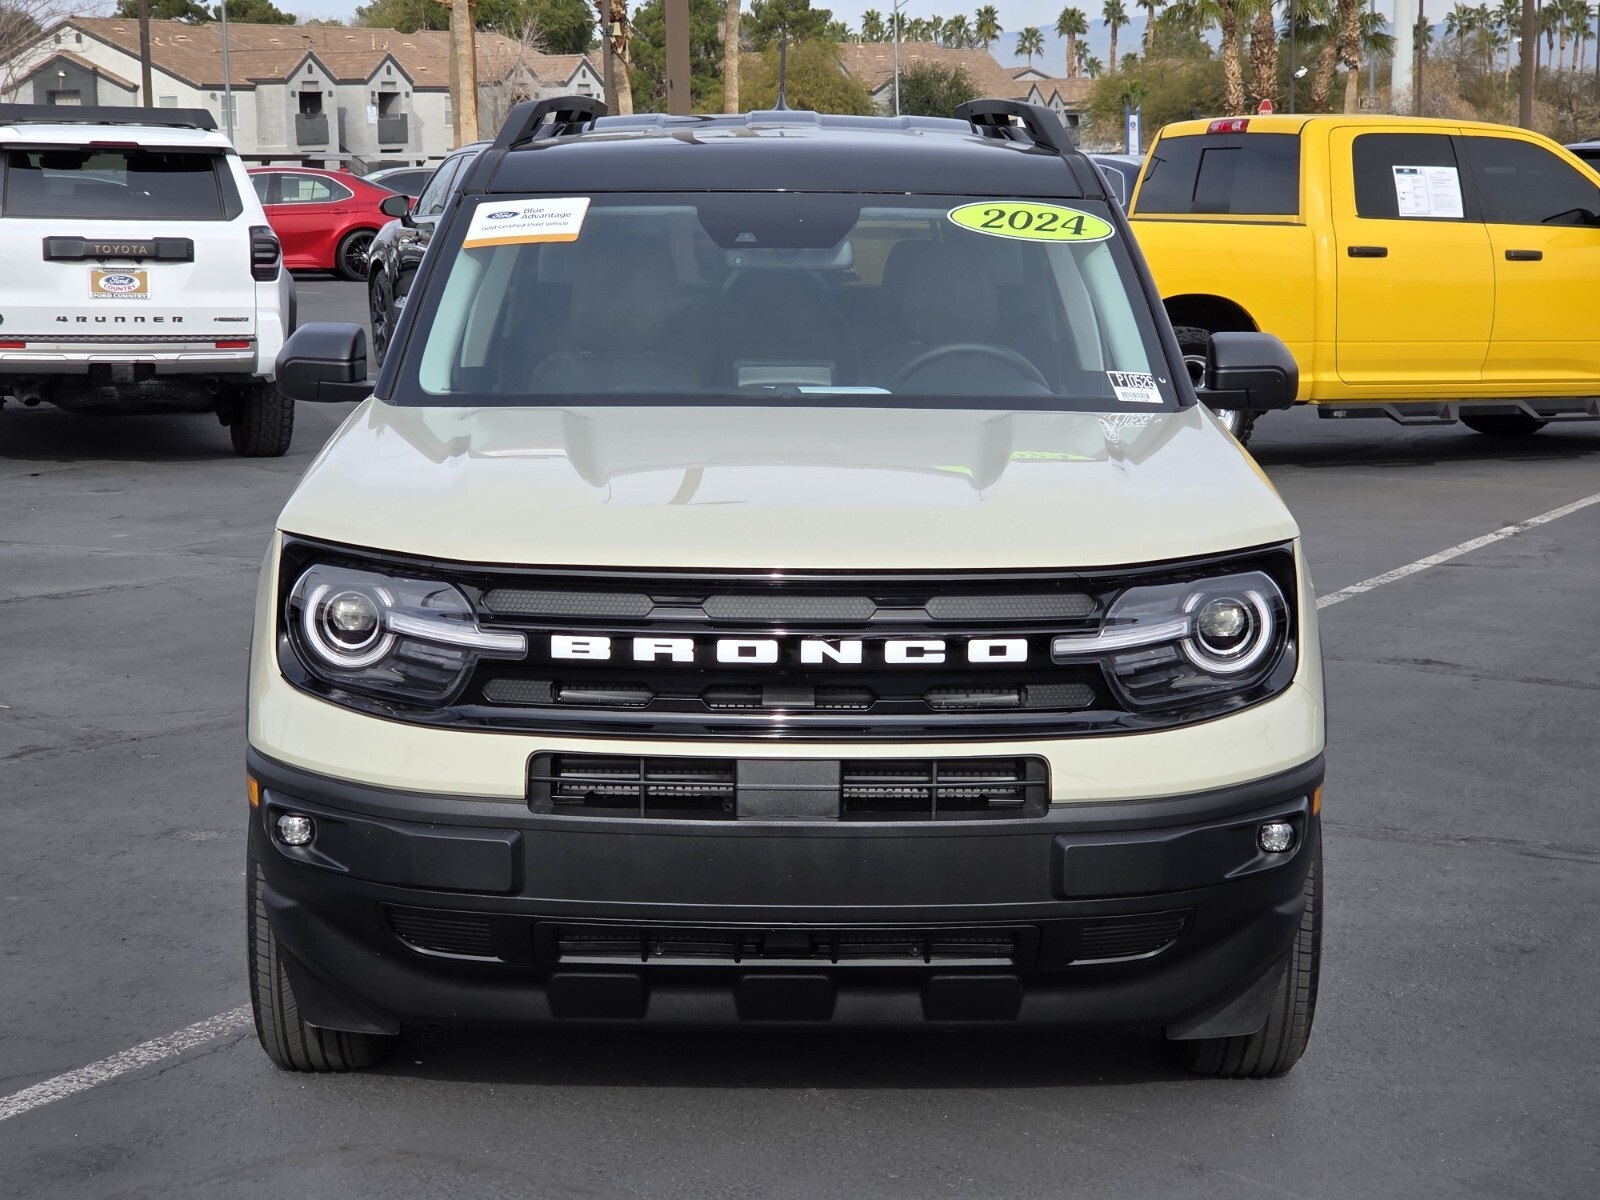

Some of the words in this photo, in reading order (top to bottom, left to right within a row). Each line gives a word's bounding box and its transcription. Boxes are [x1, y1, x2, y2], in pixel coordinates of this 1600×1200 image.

[521, 212, 572, 220] Advantage
[980, 208, 1087, 236] 2024
[94, 245, 147, 254] TOYOTA
[108, 275, 130, 285] Ford
[1115, 373, 1155, 389] P10526
[550, 635, 1028, 664] BRONCO
